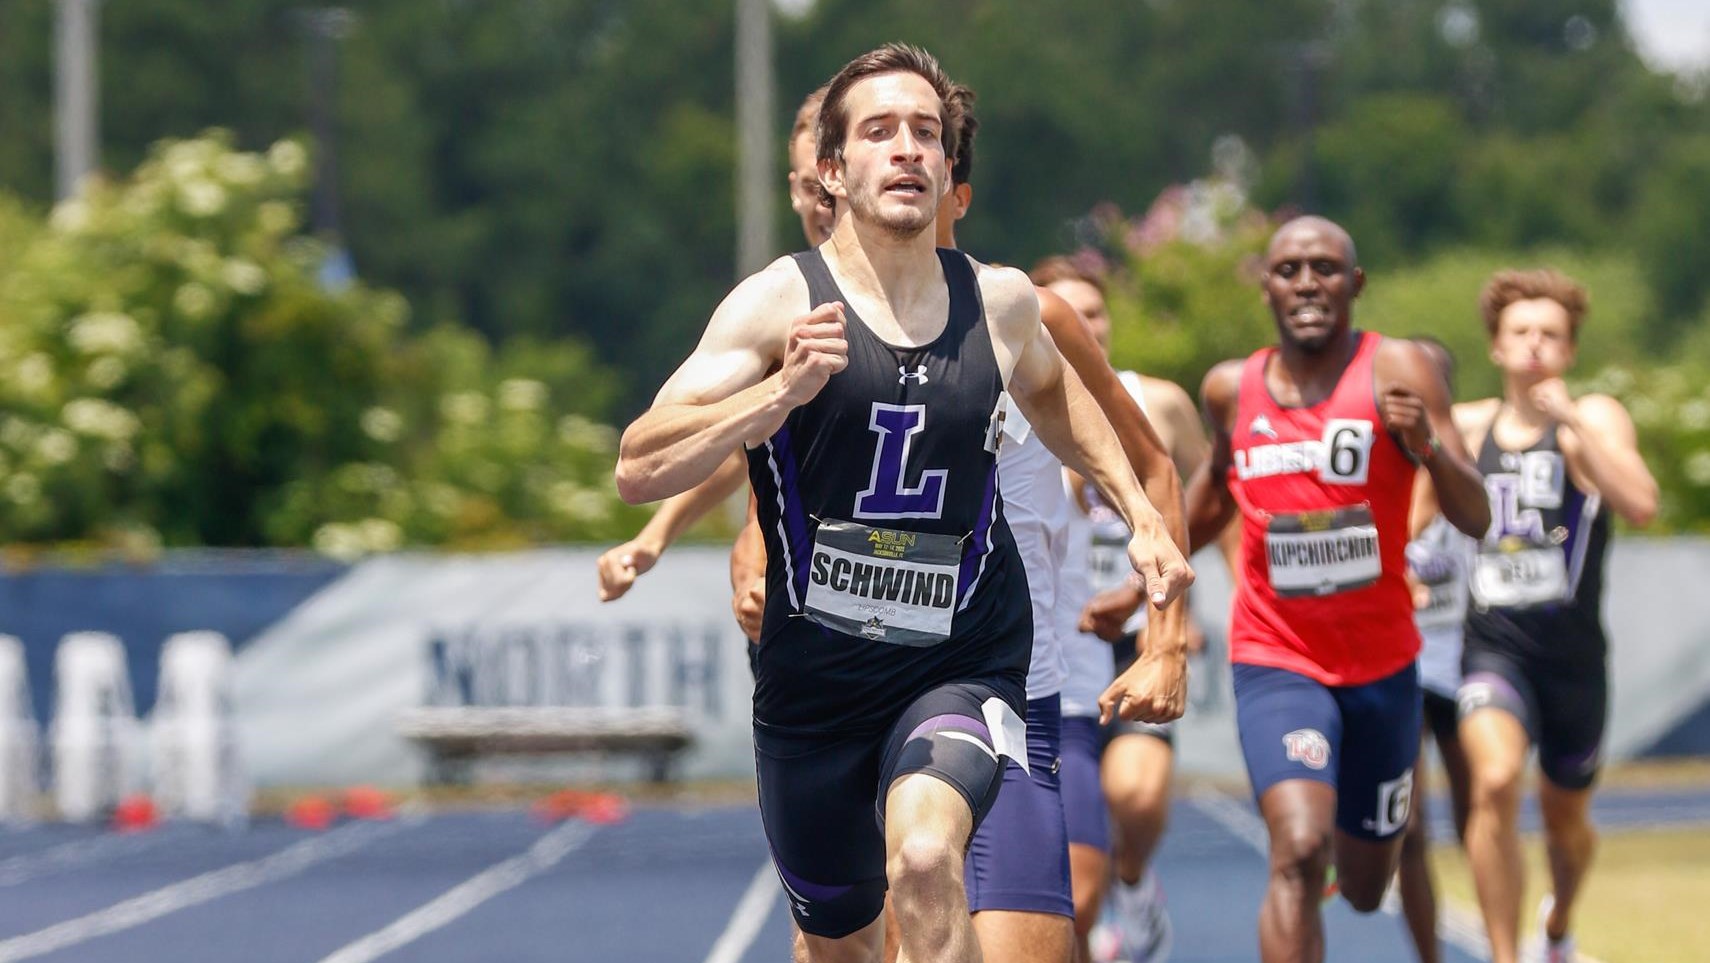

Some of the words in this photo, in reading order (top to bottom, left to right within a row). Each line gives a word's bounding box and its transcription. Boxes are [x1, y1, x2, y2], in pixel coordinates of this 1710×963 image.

[853, 402, 948, 519] L
[1330, 427, 1360, 477] 6
[867, 529, 916, 546] ASUN
[811, 551, 955, 609] SCHWIND
[1387, 782, 1409, 824] 6
